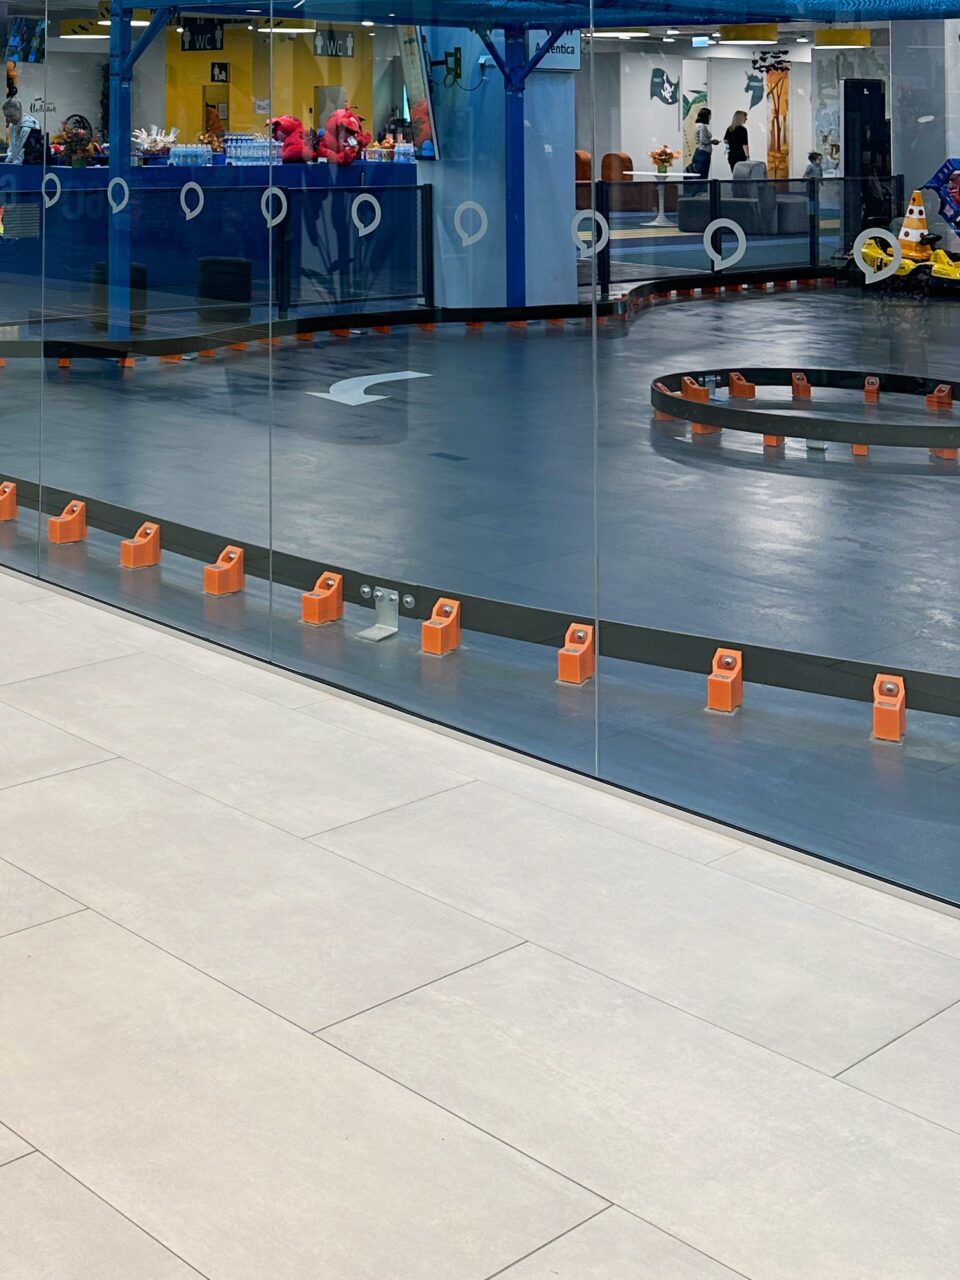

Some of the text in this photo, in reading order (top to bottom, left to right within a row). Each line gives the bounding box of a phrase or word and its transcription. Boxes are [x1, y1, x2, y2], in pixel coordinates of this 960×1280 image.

[194, 34, 212, 49] WC
[327, 40, 344, 56] WC
[535, 42, 575, 55] Aentica
